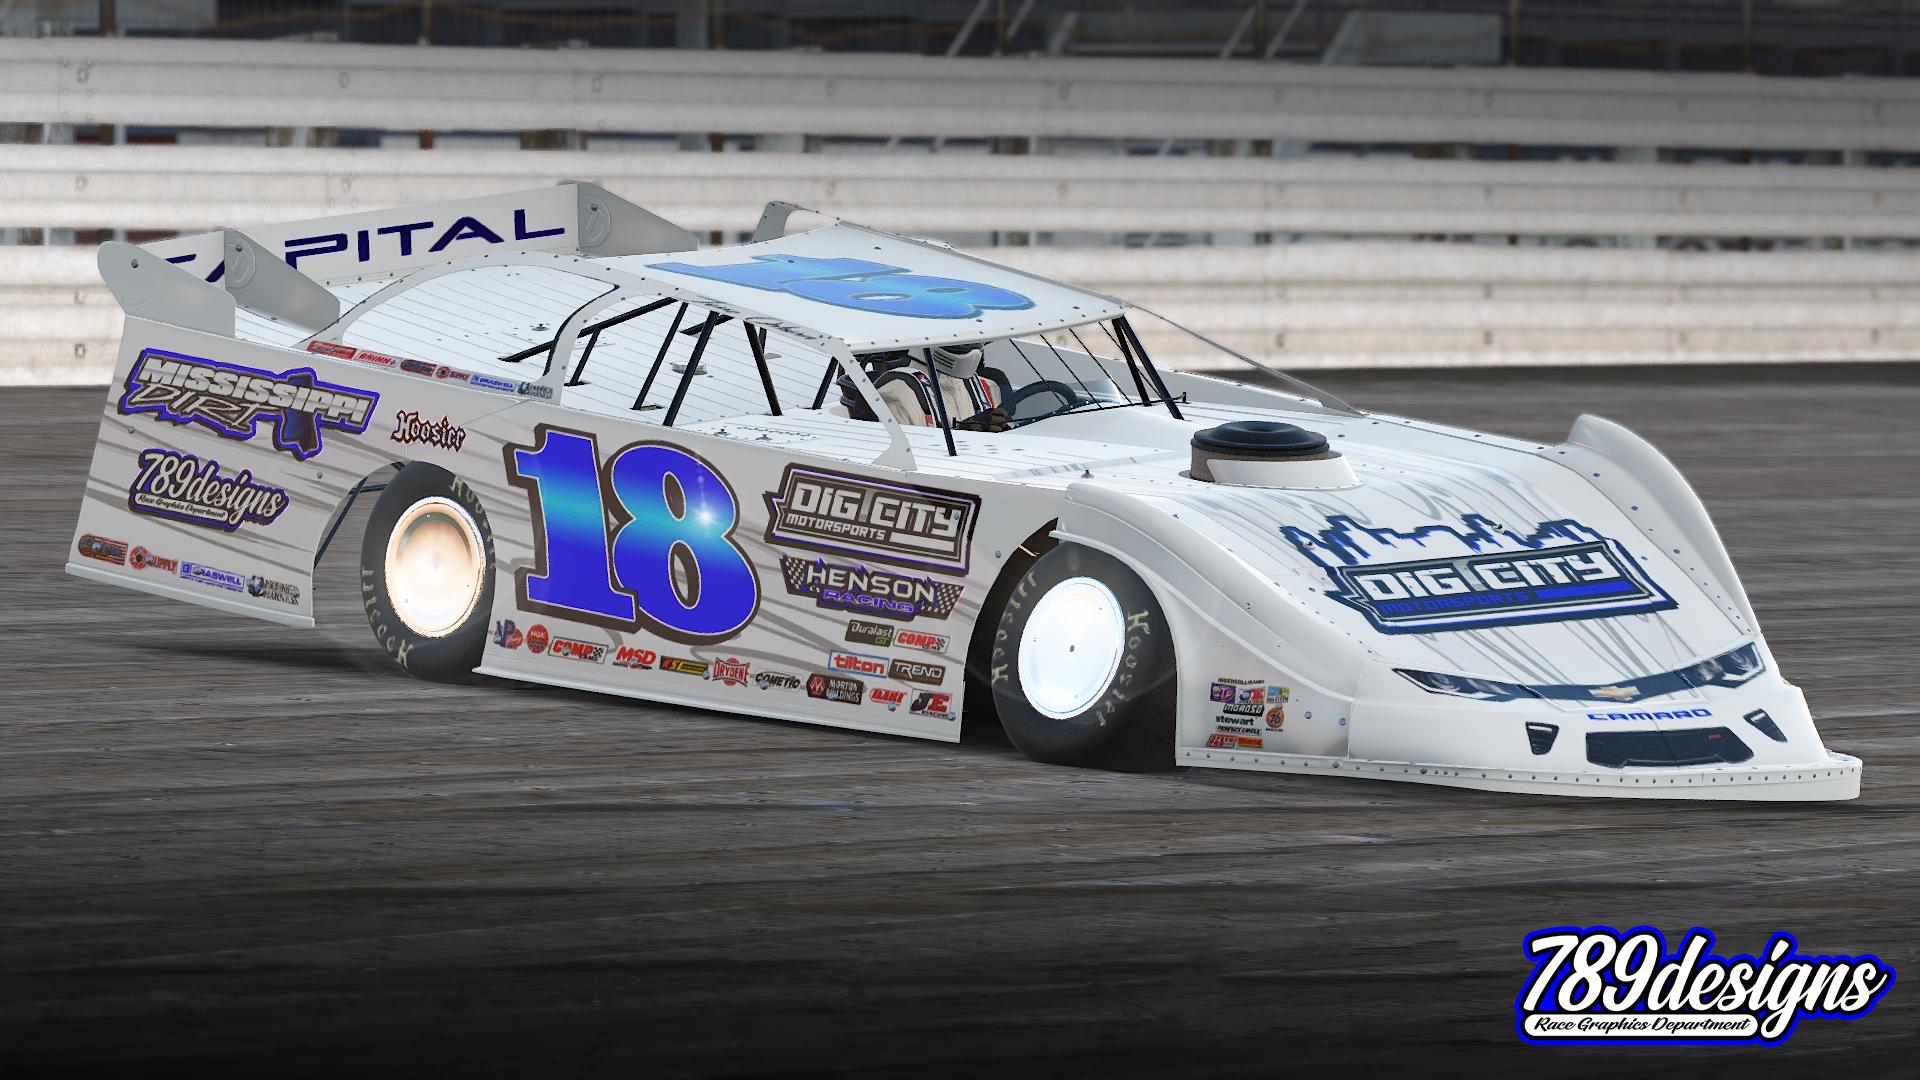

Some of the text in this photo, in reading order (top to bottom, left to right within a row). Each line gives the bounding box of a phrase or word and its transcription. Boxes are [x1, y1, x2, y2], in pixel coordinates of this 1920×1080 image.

[646, 254, 1036, 320] 18
[138, 357, 371, 424] MISSISSIPPI
[127, 382, 281, 430] DIRT
[391, 410, 466, 452] Hoosier
[136, 452, 283, 525] 789designs
[790, 482, 962, 538] DIG CITY
[504, 423, 761, 645] 18
[785, 514, 886, 541] MOTORSPORTS
[149, 555, 178, 573] UPPLY
[1355, 551, 1622, 601] DIG CITY
[806, 564, 935, 602] HENSON
[823, 588, 914, 613] RACING
[1379, 590, 1530, 614] MOTORSPORTS
[851, 621, 893, 637] Duralast
[897, 631, 938, 650] COMP
[616, 646, 657, 666] MSD
[834, 654, 885, 675] tilton
[895, 662, 943, 678] TREND
[829, 678, 858, 692] MORTON
[910, 692, 950, 713] JE
[1587, 708, 1712, 721] CAMARO
